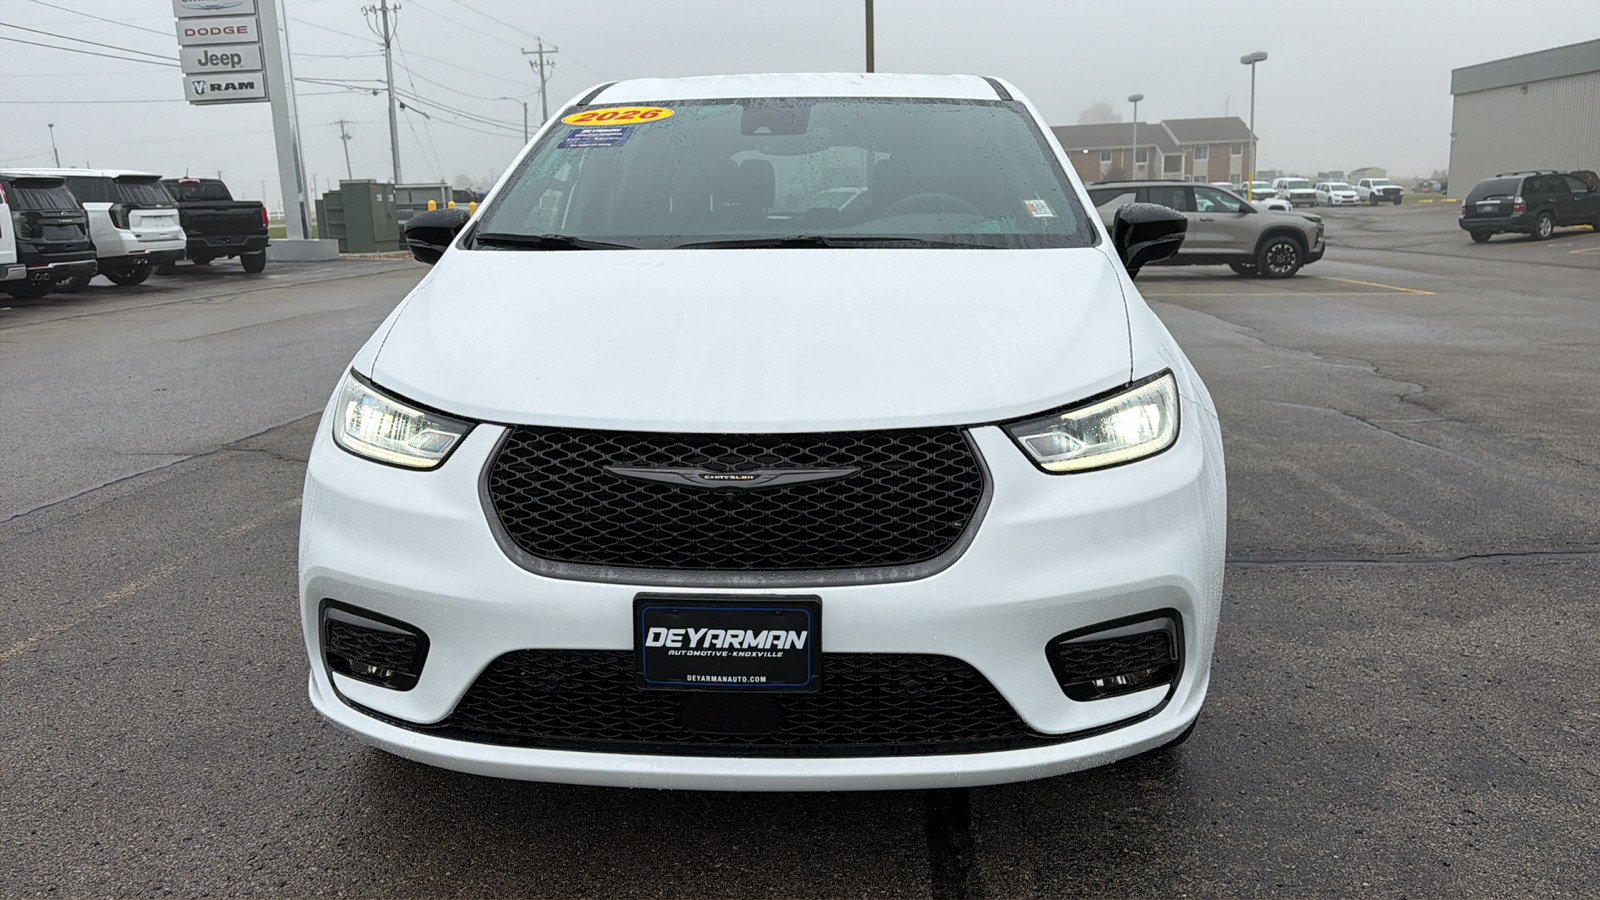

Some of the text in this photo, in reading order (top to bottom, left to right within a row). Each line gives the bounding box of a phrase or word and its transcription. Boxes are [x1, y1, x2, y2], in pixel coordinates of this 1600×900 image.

[184, 25, 248, 37] DODGE
[197, 50, 242, 68] Jeep
[210, 82, 255, 92] RAM
[572, 109, 663, 123] 2026
[645, 627, 808, 650] DEYARMAN
[686, 674, 767, 683] DEYARMANAUTO.COM
